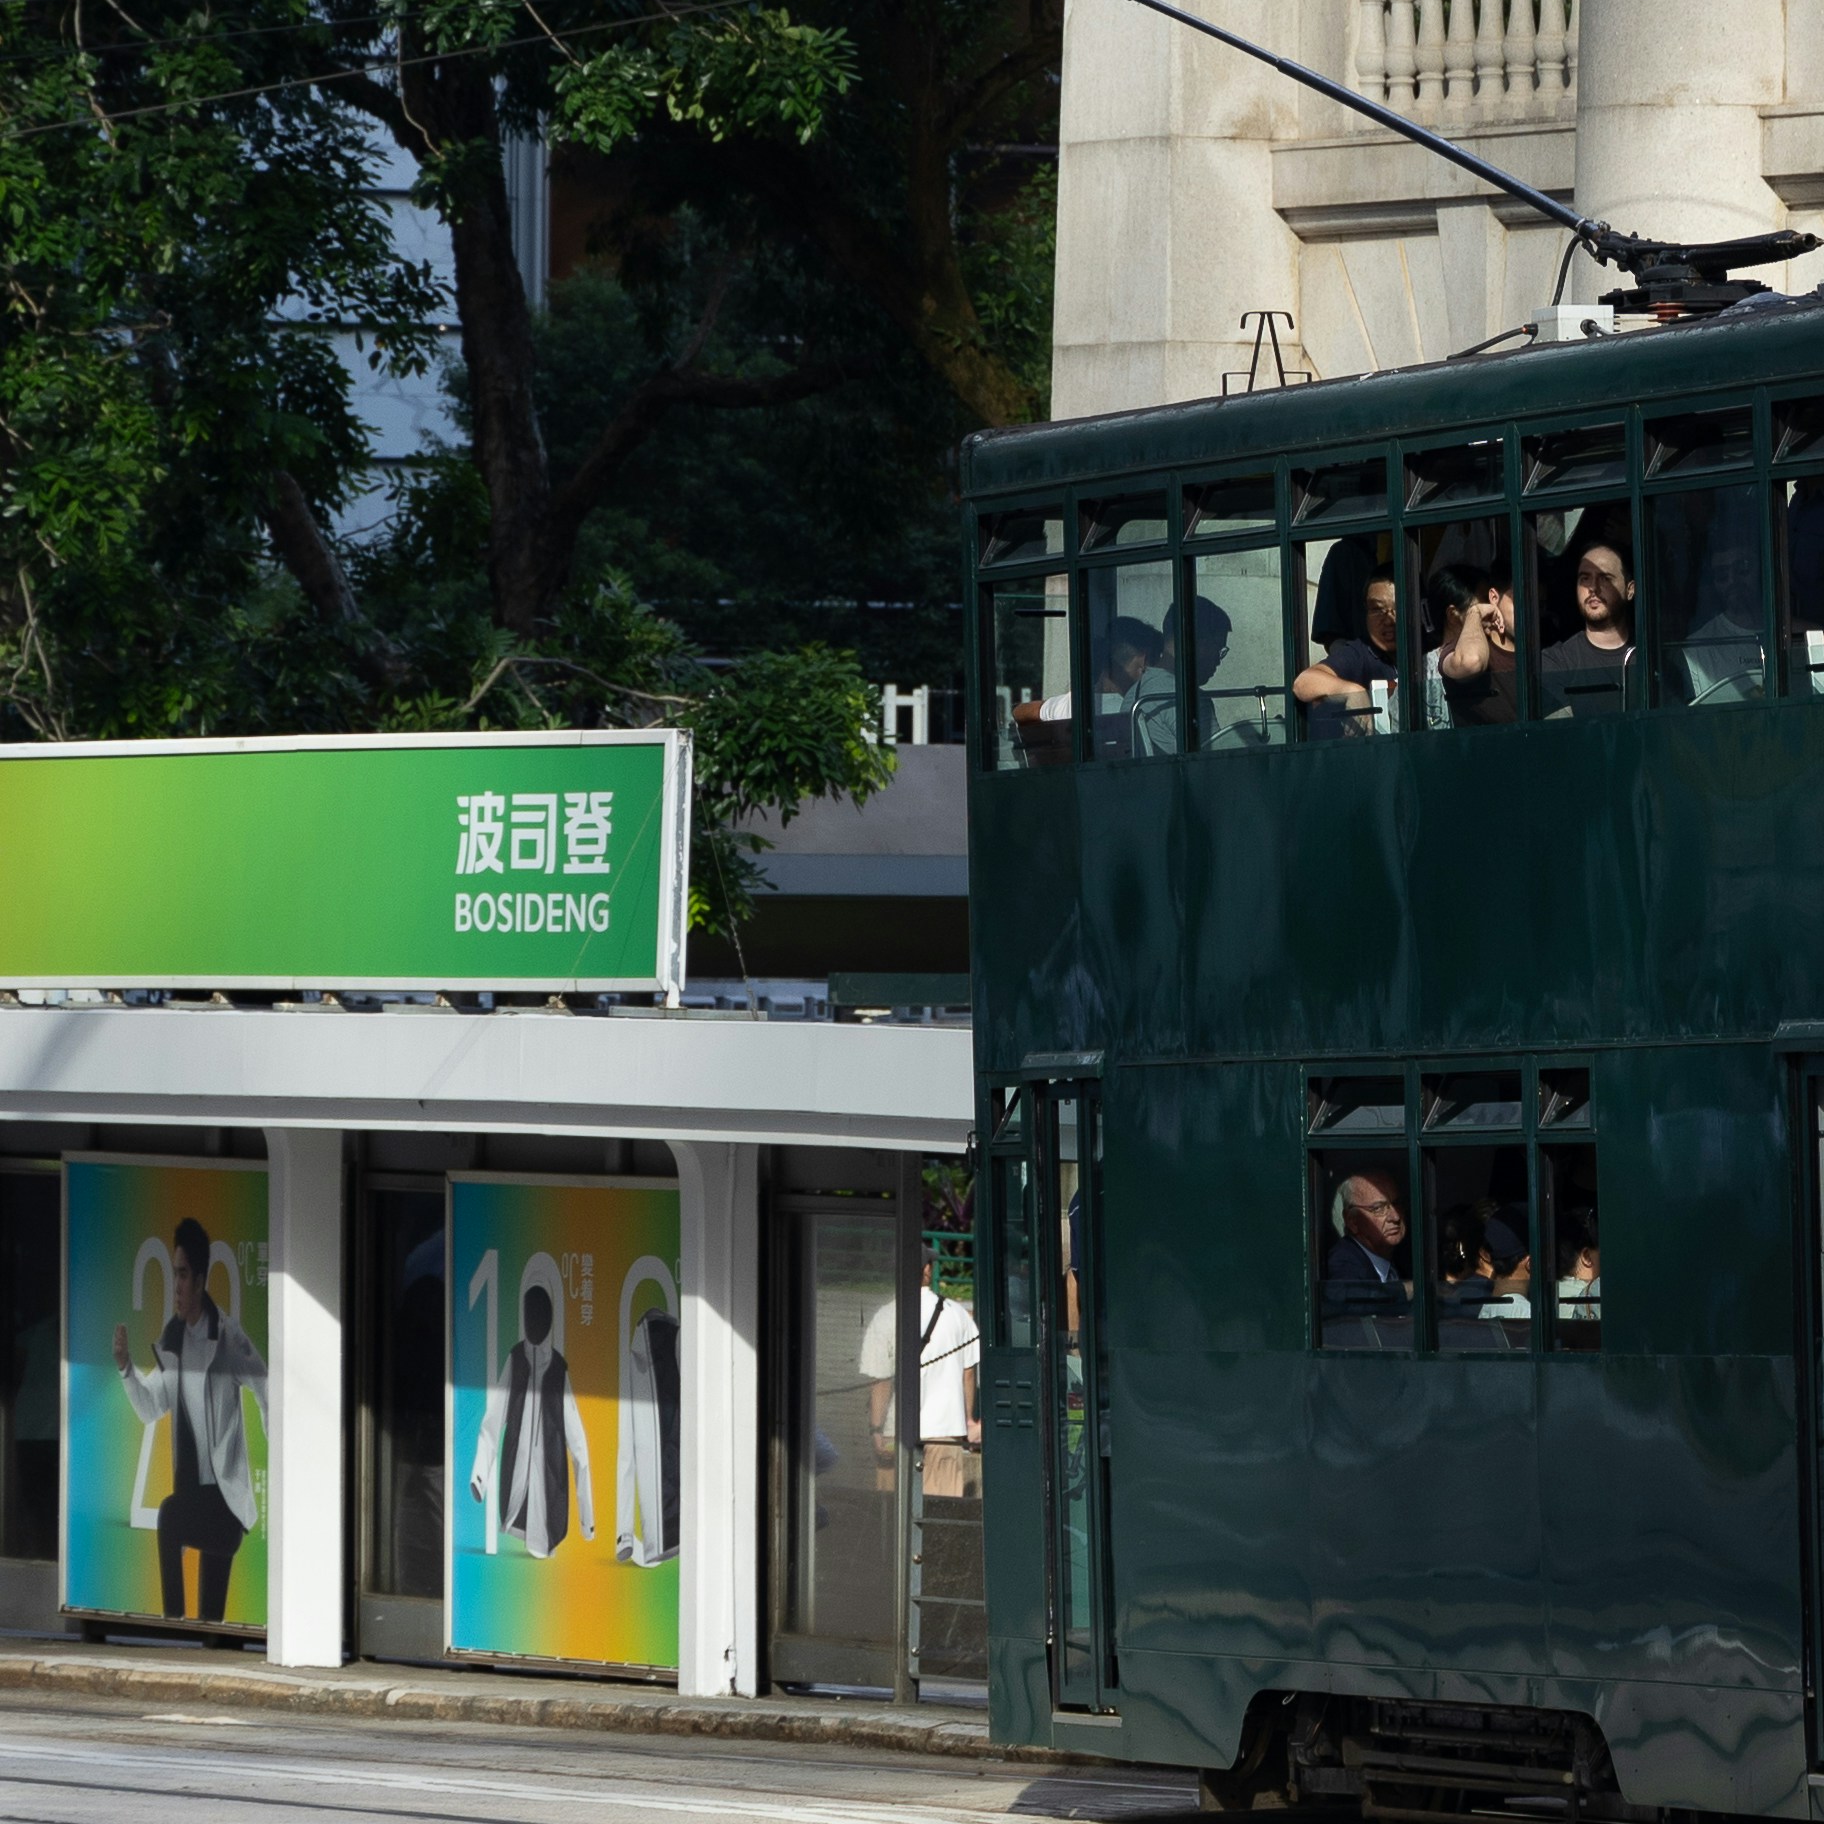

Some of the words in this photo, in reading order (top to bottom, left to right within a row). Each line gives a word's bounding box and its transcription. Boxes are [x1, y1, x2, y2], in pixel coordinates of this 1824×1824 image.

[455, 791, 613, 874] 波司登
[455, 892, 609, 933] BOSIDENG
